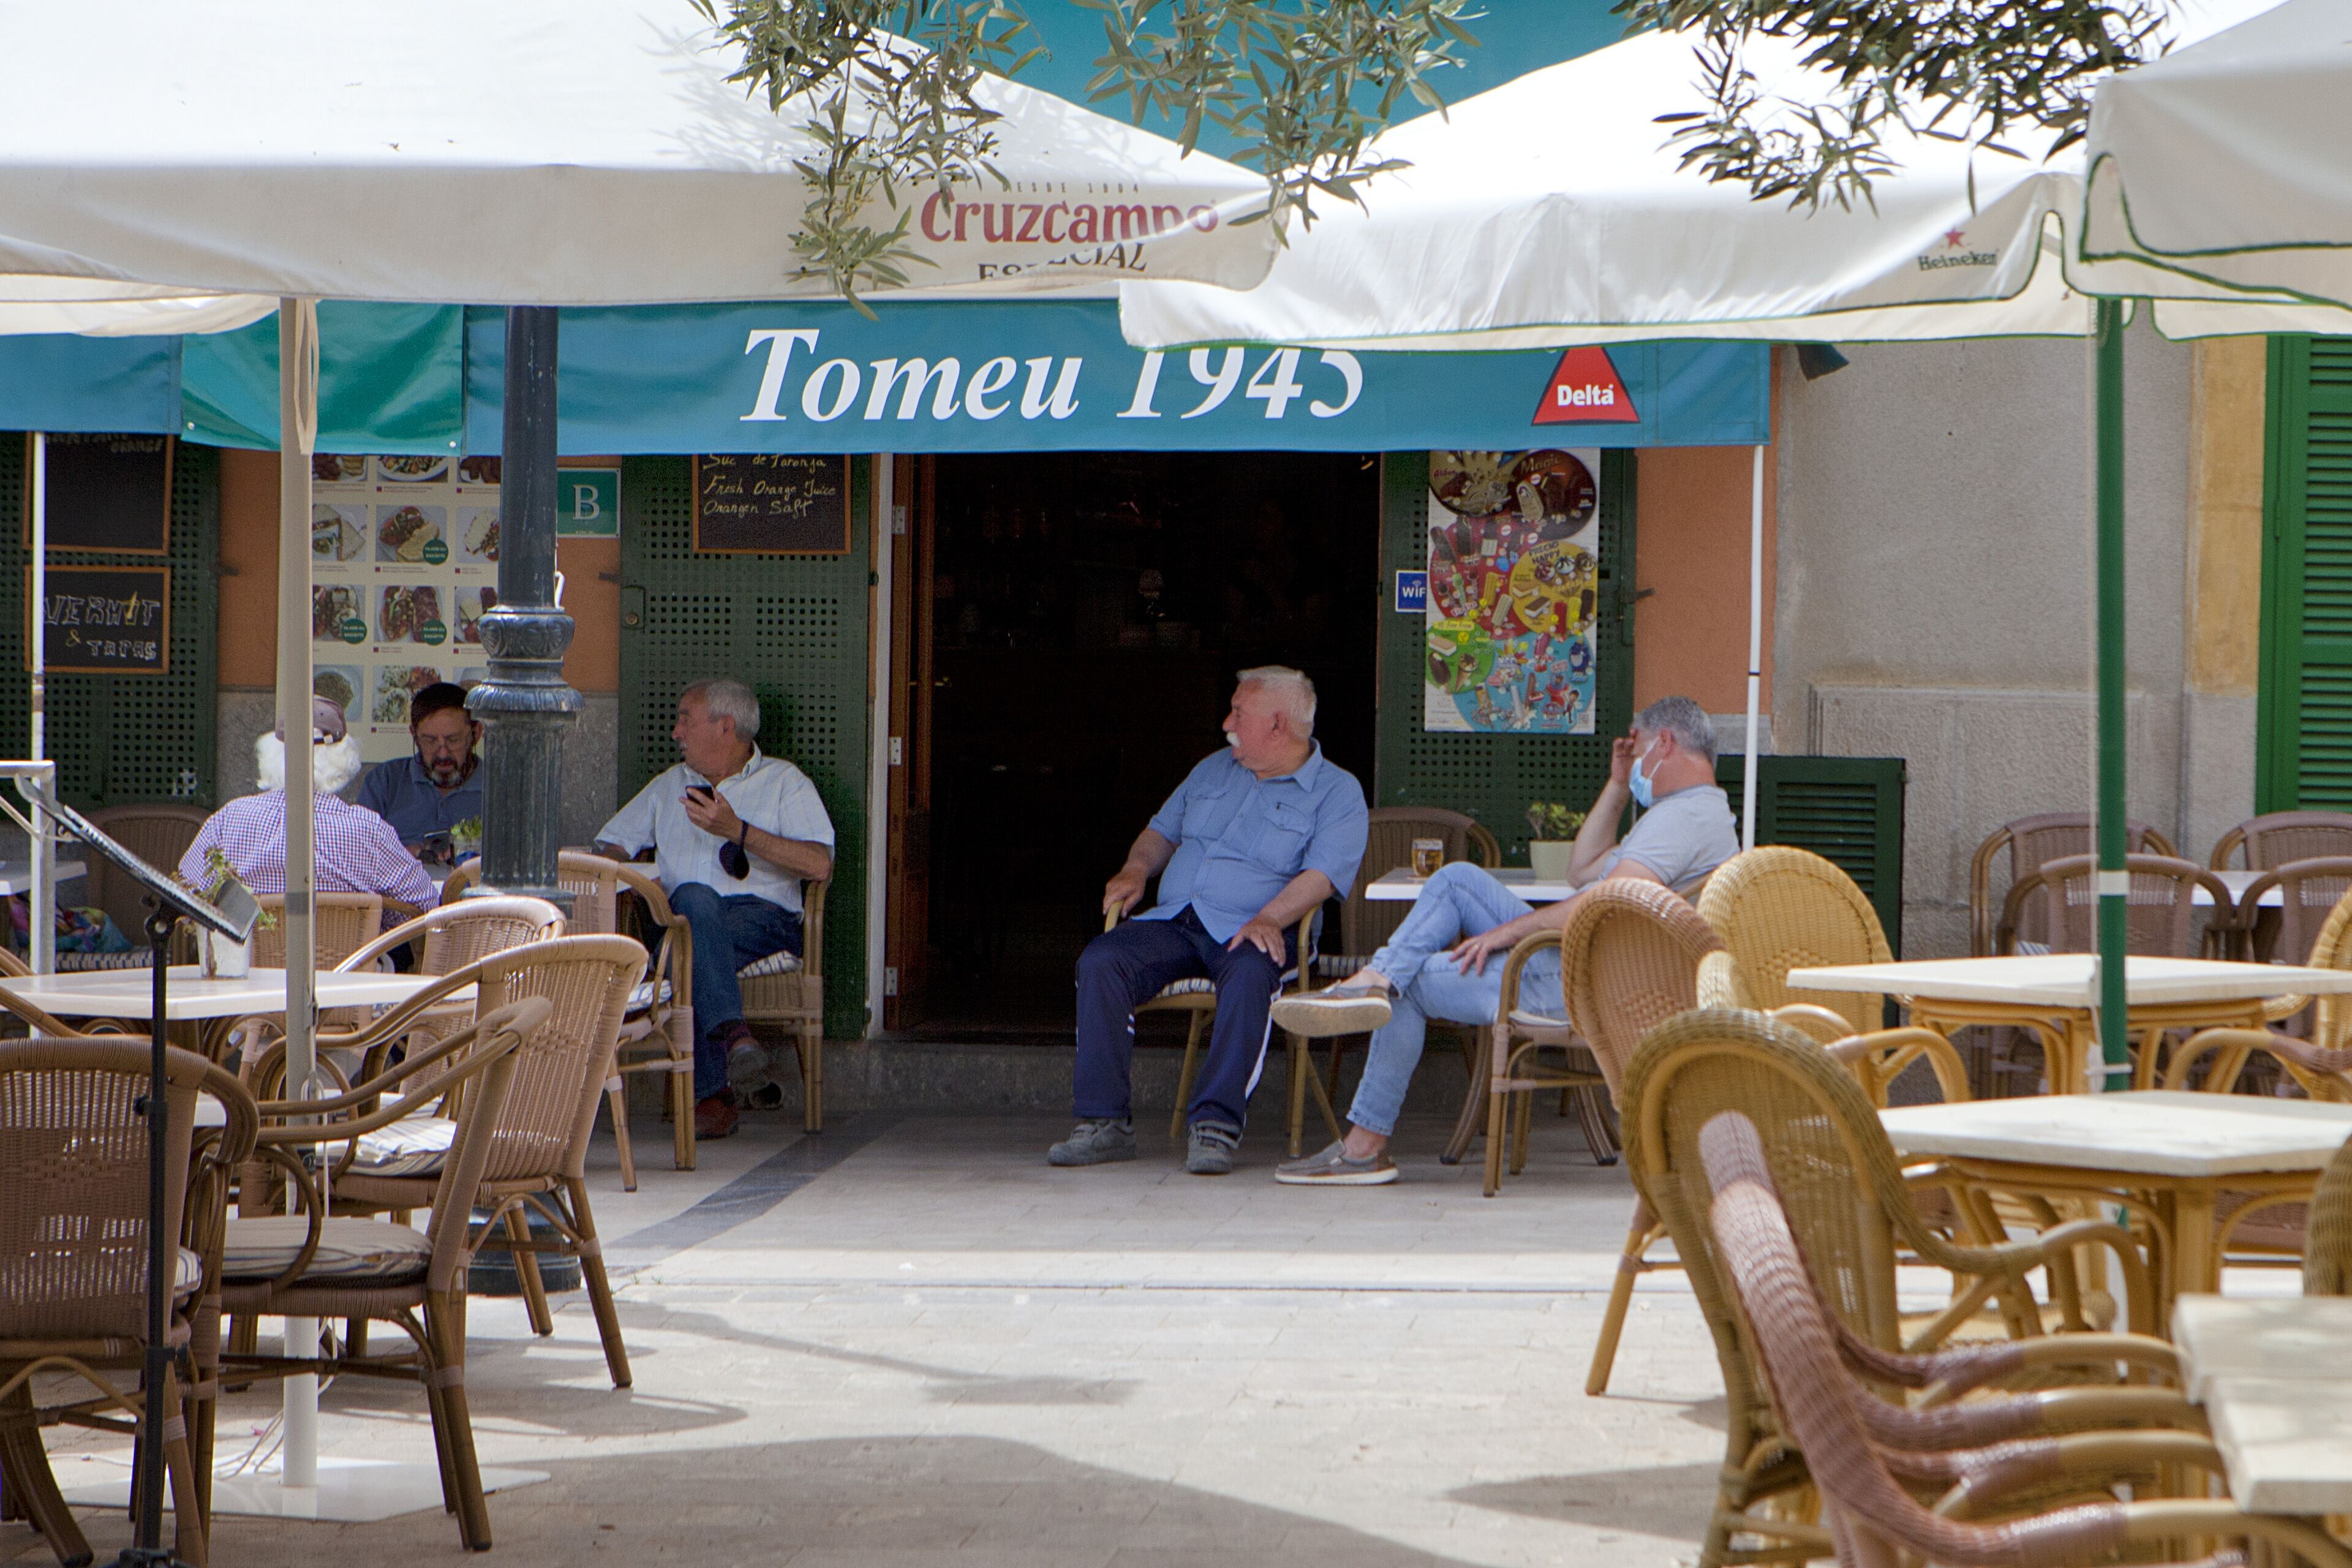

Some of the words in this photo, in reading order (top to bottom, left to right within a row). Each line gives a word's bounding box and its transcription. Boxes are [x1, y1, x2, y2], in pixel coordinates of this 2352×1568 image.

[921, 187, 1219, 243] Cruzcampo
[740, 329, 1083, 421] Tomeu
[1117, 347, 1363, 419] 1945
[1558, 384, 1615, 407] Delta
[703, 454, 736, 470] Suc
[704, 475, 744, 494] Fresh
[753, 480, 797, 501] Orange
[803, 479, 836, 497] Juice
[572, 484, 600, 520] B
[704, 500, 759, 518] Orangen
